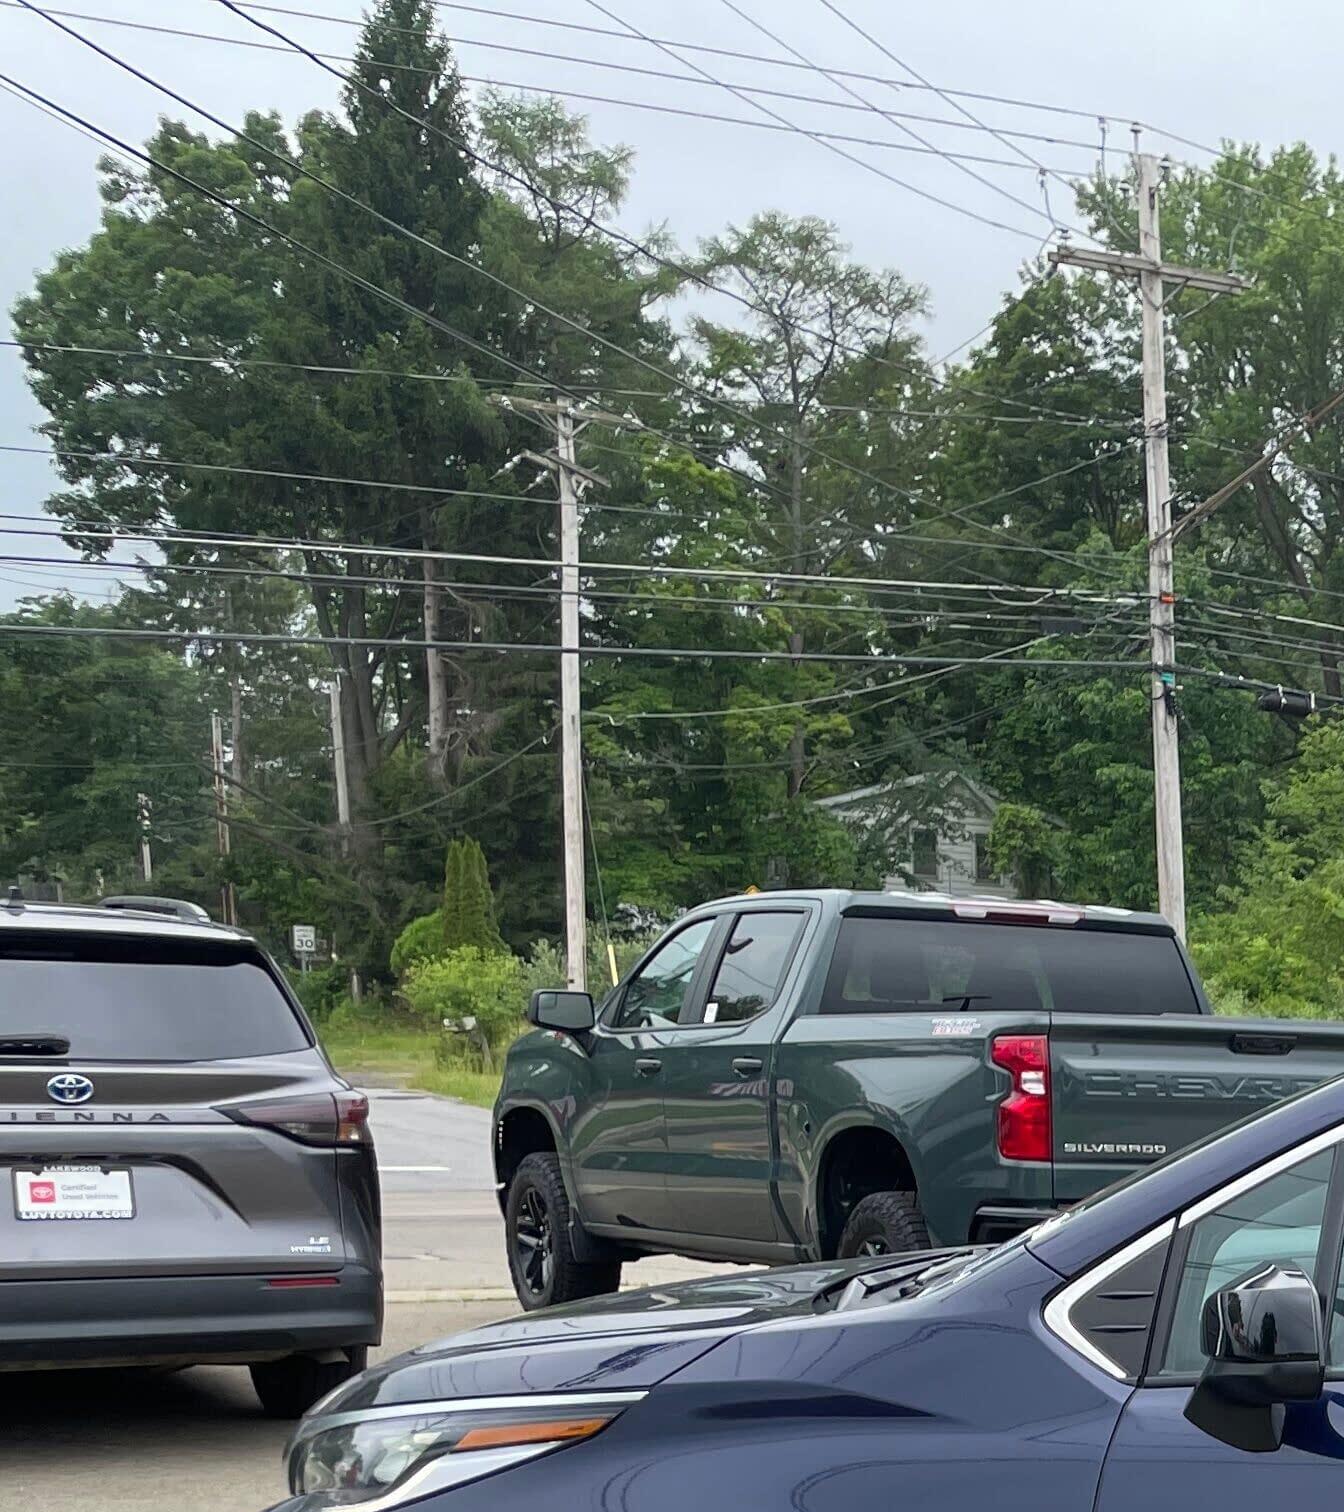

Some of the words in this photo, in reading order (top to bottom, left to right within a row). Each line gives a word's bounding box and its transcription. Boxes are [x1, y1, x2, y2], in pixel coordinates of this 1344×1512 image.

[296, 939, 313, 949] 30
[1084, 1073, 1327, 1099] CHEVR
[9, 1111, 171, 1121] IENNA
[1064, 1143, 1167, 1154] SILVERADO
